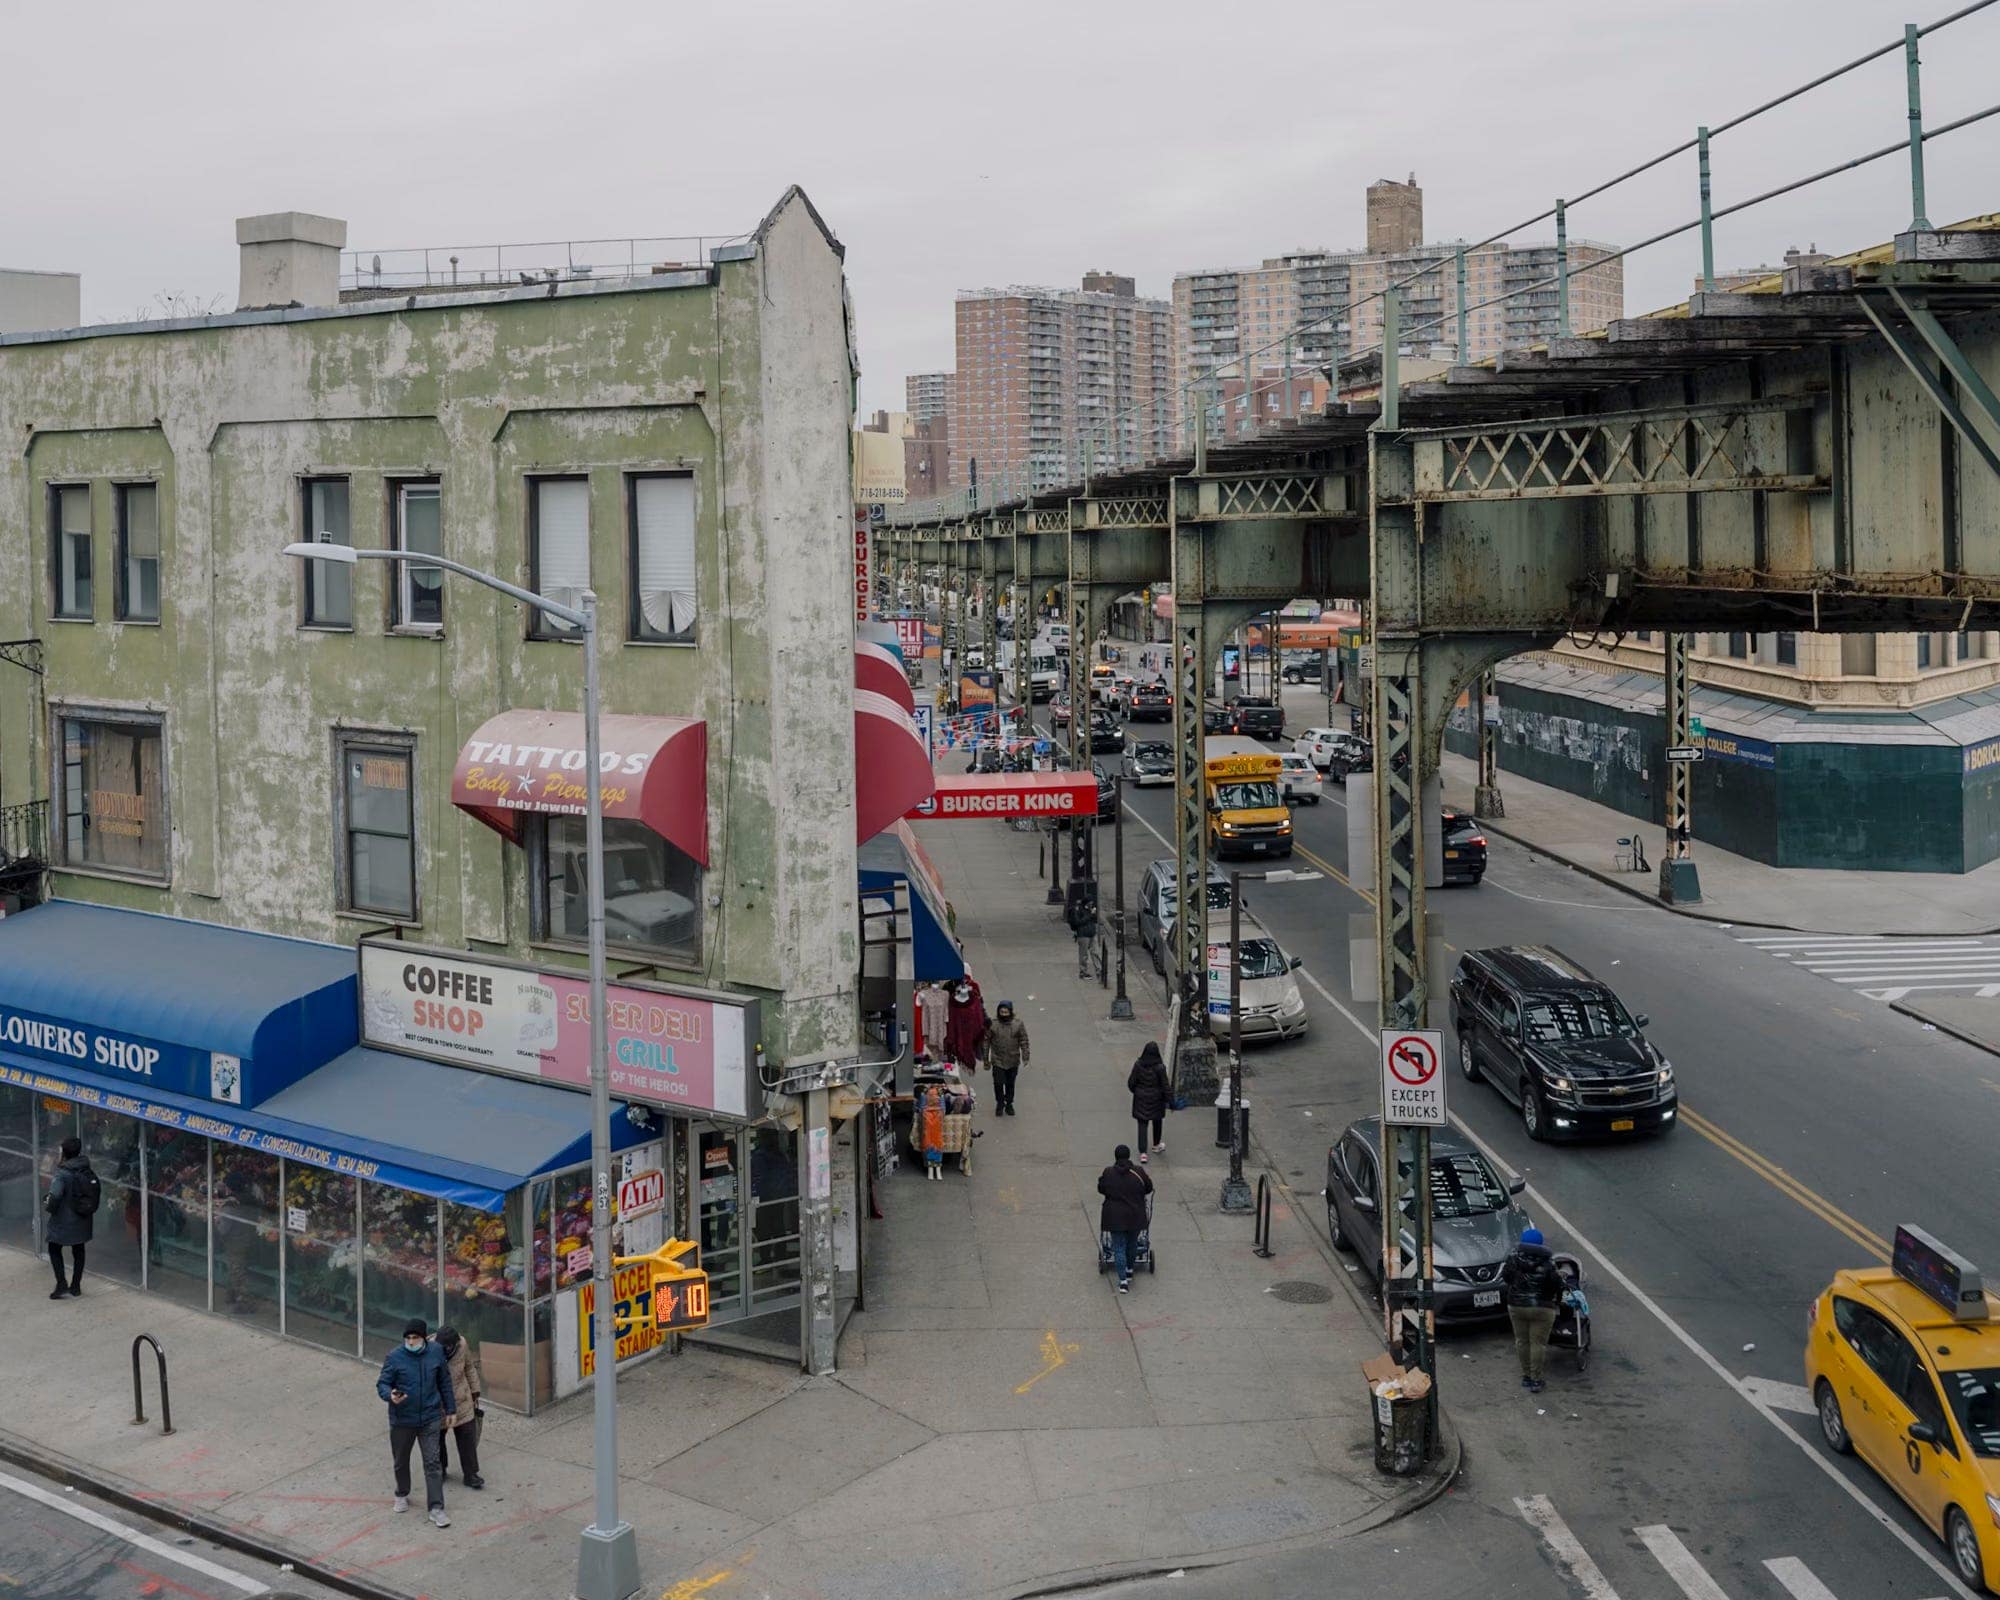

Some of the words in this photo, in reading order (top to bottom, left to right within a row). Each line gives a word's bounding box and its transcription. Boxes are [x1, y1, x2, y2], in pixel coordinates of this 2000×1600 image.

[469, 741, 649, 775] TATTOOS
[1707, 737, 1738, 755] COLLEGE
[465, 767, 511, 795] Body
[497, 797, 531, 810] Body
[943, 795, 1020, 812] BURGER
[1024, 792, 1073, 810] KING
[403, 964, 493, 1005] COFFEE
[414, 1000, 483, 1036] SHOP
[650, 1006, 701, 1043] DELI
[94, 1035, 160, 1076] SHOP
[615, 1036, 680, 1076] GRILL
[611, 1070, 625, 1082] OF
[628, 1074, 648, 1088] THE
[1391, 1089, 1436, 1102] EXCEPT
[1391, 1105, 1438, 1119] TRUCKS
[185, 1115, 235, 1137] ANNIVERSARY
[238, 1127, 257, 1143] GIFT
[260, 1134, 332, 1166] CONGRATULATIONS
[336, 1155, 358, 1173] NEW
[356, 1159, 380, 1178] BABY
[624, 1174, 660, 1210] ATM
[687, 1284, 706, 1318] 10
[618, 1327, 663, 1359] STAMPS
